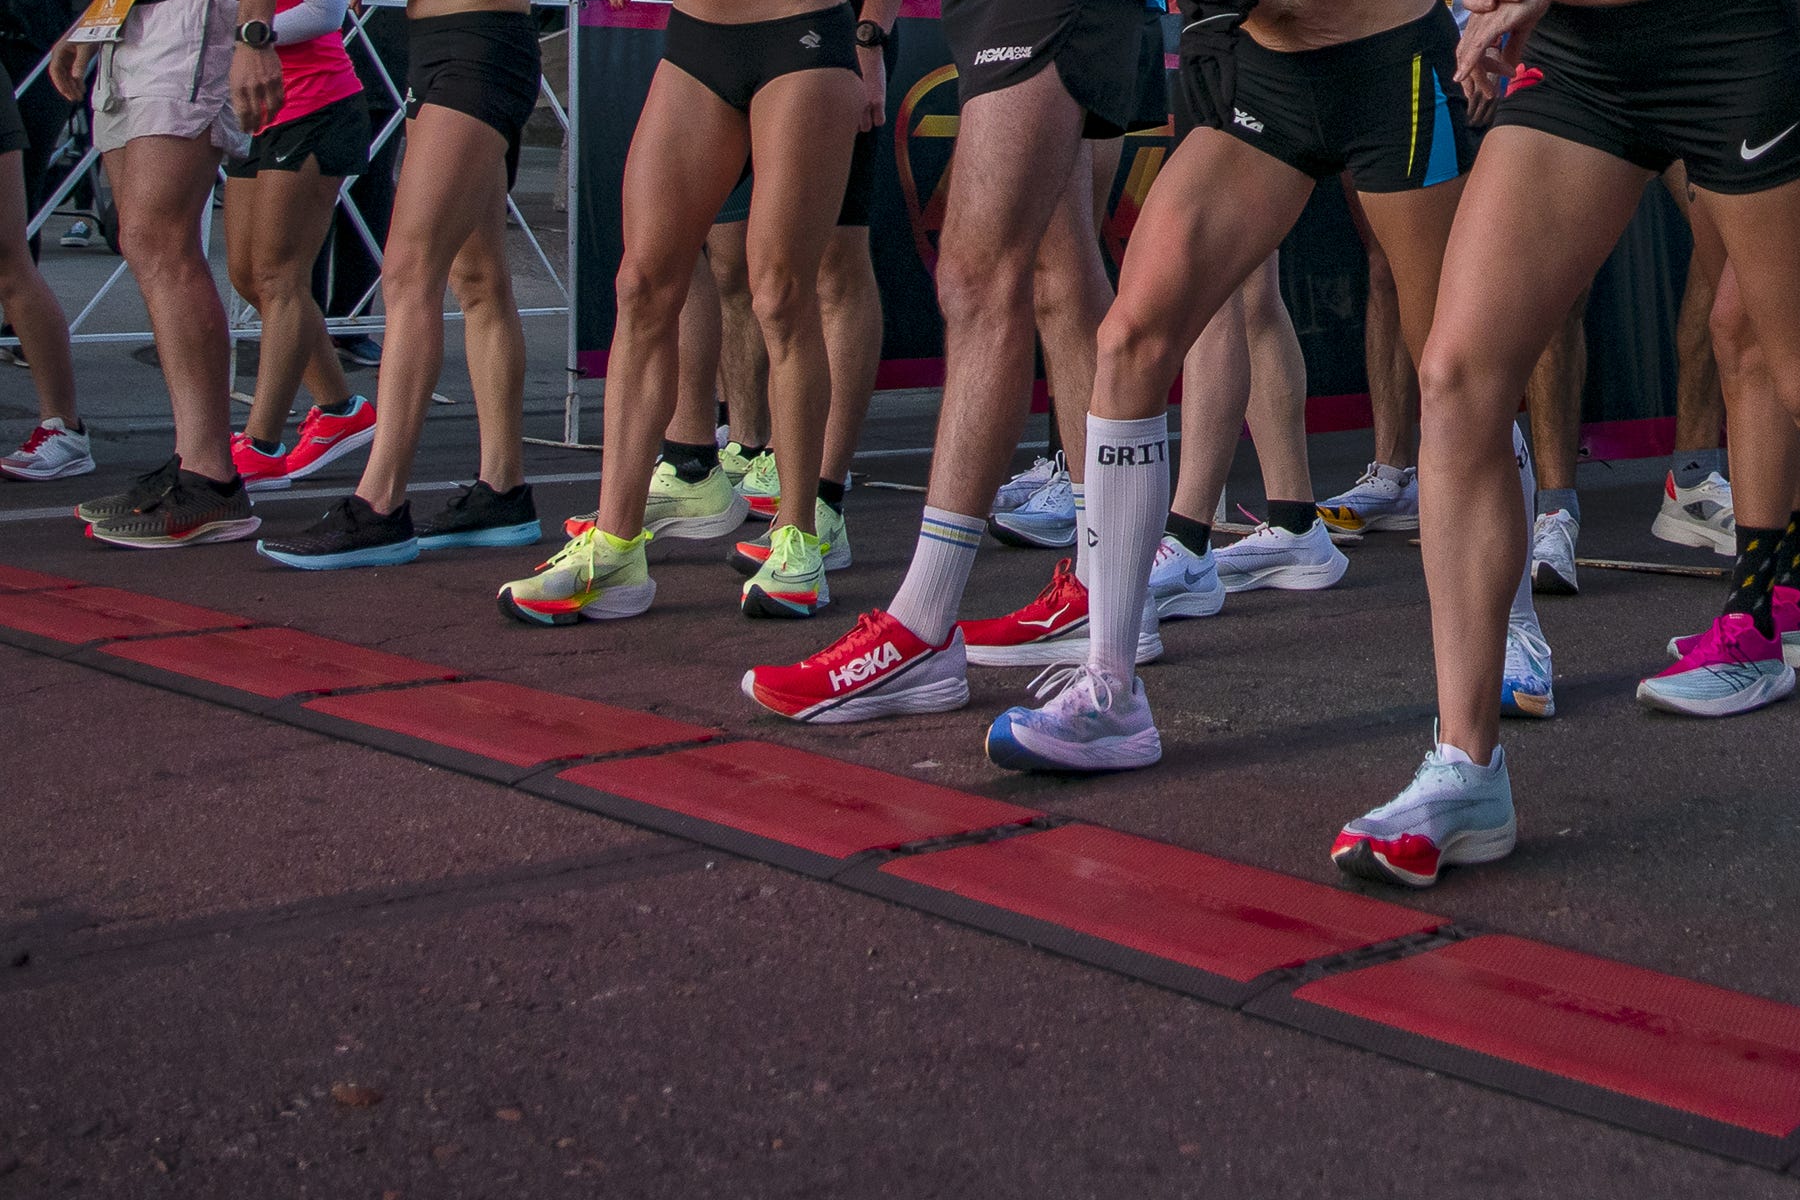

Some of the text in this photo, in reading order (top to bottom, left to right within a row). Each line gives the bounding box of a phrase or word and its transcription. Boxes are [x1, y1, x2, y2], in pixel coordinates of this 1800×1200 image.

[974, 46, 1014, 65] HOKA
[1097, 440, 1166, 467] GRIT
[828, 641, 903, 692] HOKA
